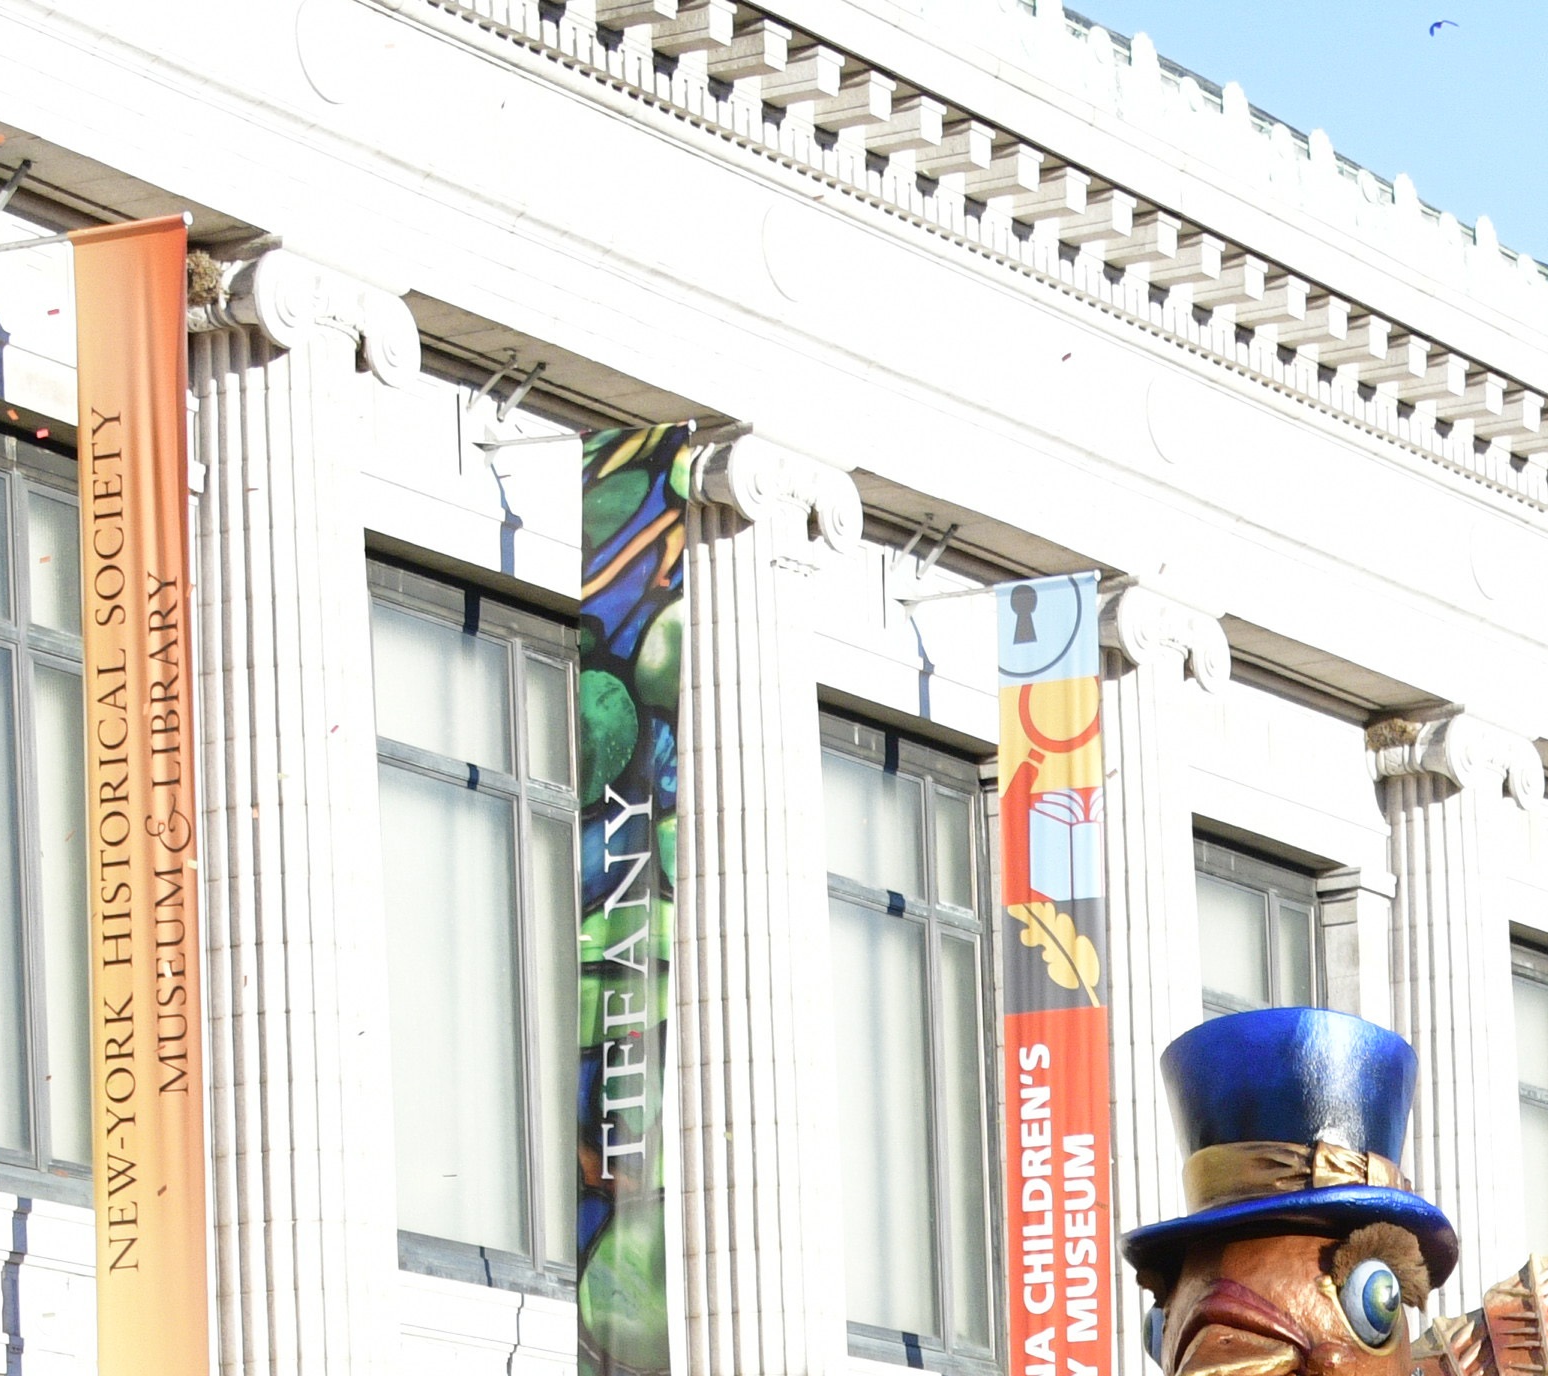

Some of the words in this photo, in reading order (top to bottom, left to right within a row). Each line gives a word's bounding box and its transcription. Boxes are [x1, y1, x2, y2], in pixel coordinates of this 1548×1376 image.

[91, 406, 127, 625] SOCIETY
[146, 568, 182, 788] LIBRARY
[95, 646, 138, 976] HISTORICAL
[144, 793, 193, 855] &
[154, 864, 190, 1097] MUSEUM
[602, 785, 652, 1182] TIFFANY
[102, 996, 140, 1276] NEW-YORK
[1017, 1042, 1053, 1319] CHILDREN'S
[1061, 1131, 1097, 1334] MUSEUM
